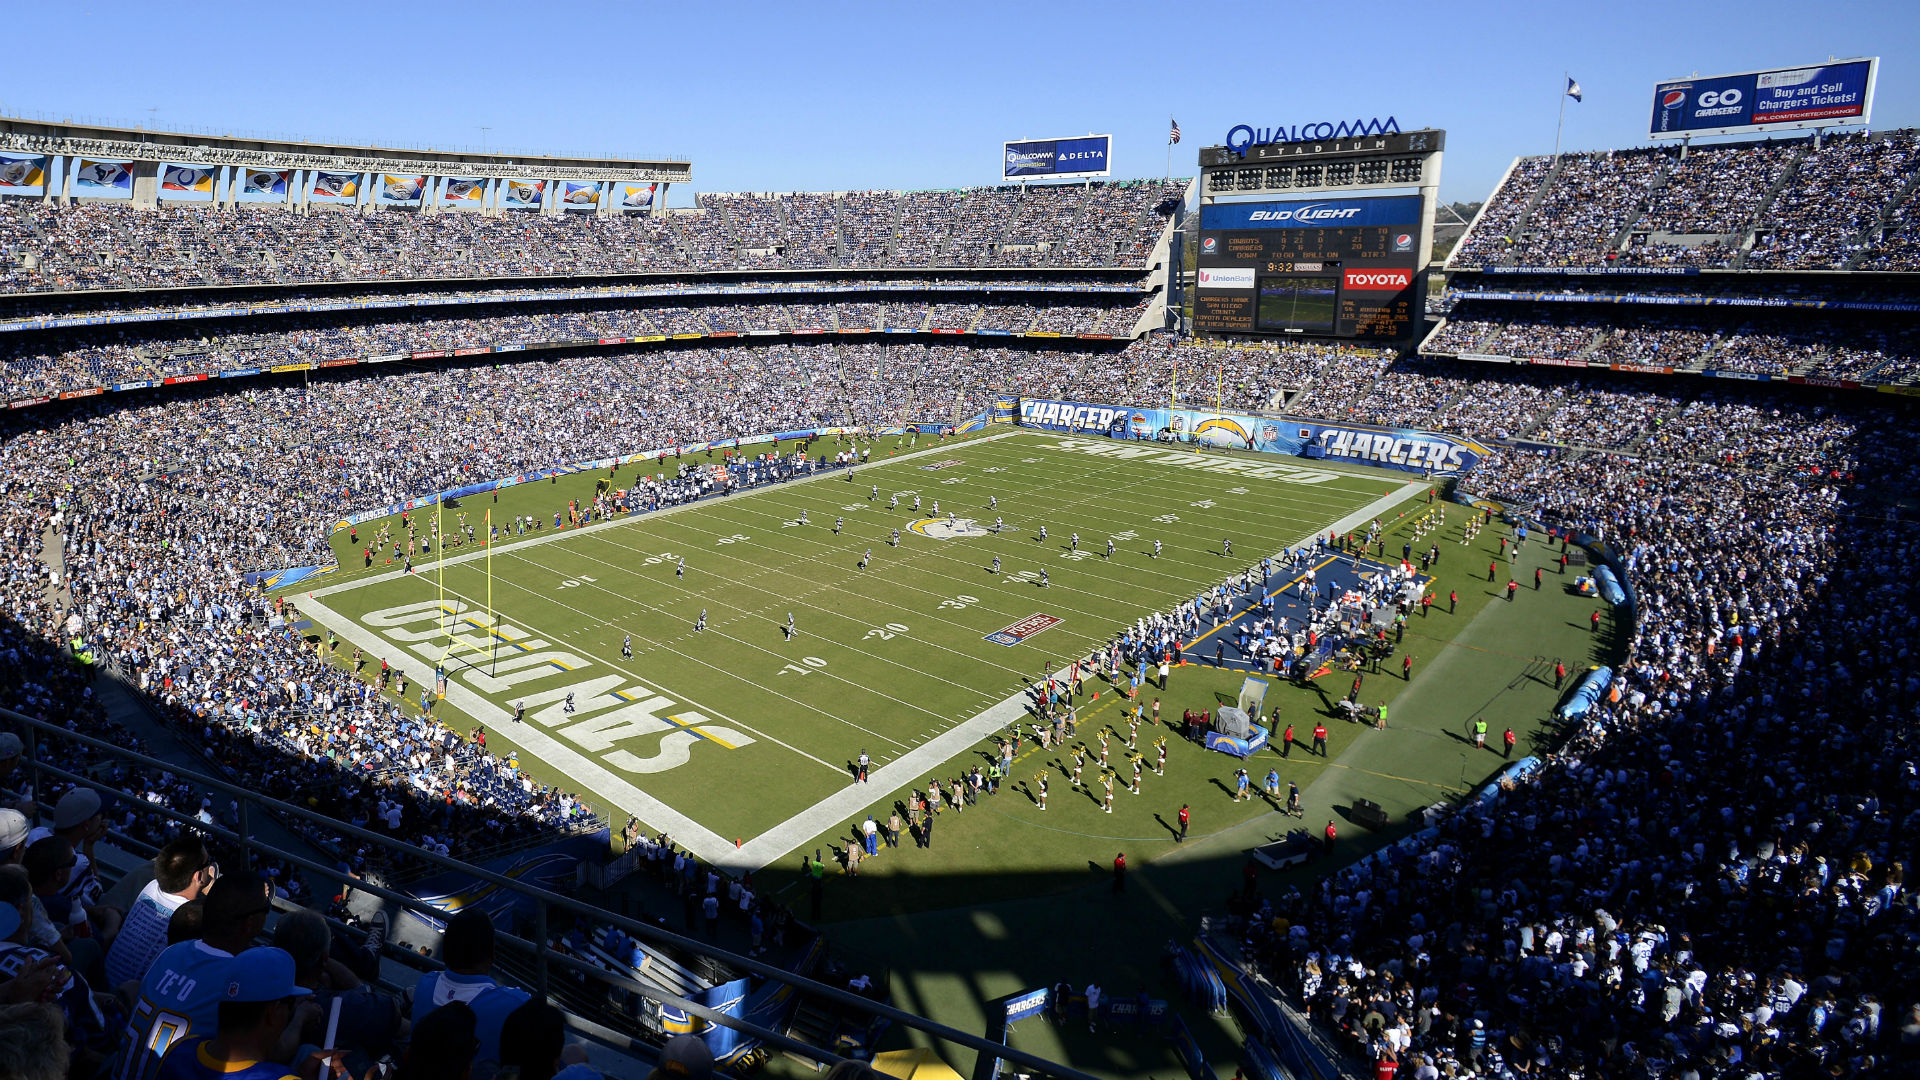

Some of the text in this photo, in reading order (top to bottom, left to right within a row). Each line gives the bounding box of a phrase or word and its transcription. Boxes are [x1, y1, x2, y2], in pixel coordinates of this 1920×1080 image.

[1774, 82, 1843, 98] Buy and Sell
[1698, 88, 1742, 108] GO
[1759, 92, 1856, 110] Chargers Tickets!
[1694, 106, 1742, 118] CHARGERS!
[1754, 108, 1856, 121] NFL.COM/TICKETEXCHANGE
[1226, 116, 1400, 157] QUALCOMM
[1259, 140, 1385, 156] STADIUM
[1070, 151, 1103, 160] DELTA
[1249, 208, 1361, 220] BUD LIGHT
[1267, 262, 1293, 272] 9:32
[1346, 274, 1408, 285] TOYOTA
[1532, 358, 1566, 366] TOSHIBA
[1618, 365, 1665, 373] CYMER
[1716, 371, 1758, 380] GEICO
[1804, 378, 1842, 387] TOYOTA
[66, 389, 98, 398] CYMER
[10, 399, 36, 408] TOSHIBA
[1320, 430, 1469, 472] CHARGERS
[784, 656, 827, 676] 10
[155, 968, 196, 1001] TE'O
[1007, 994, 1045, 1015] CHARGERS
[1112, 1004, 1164, 1015] CHARRS
